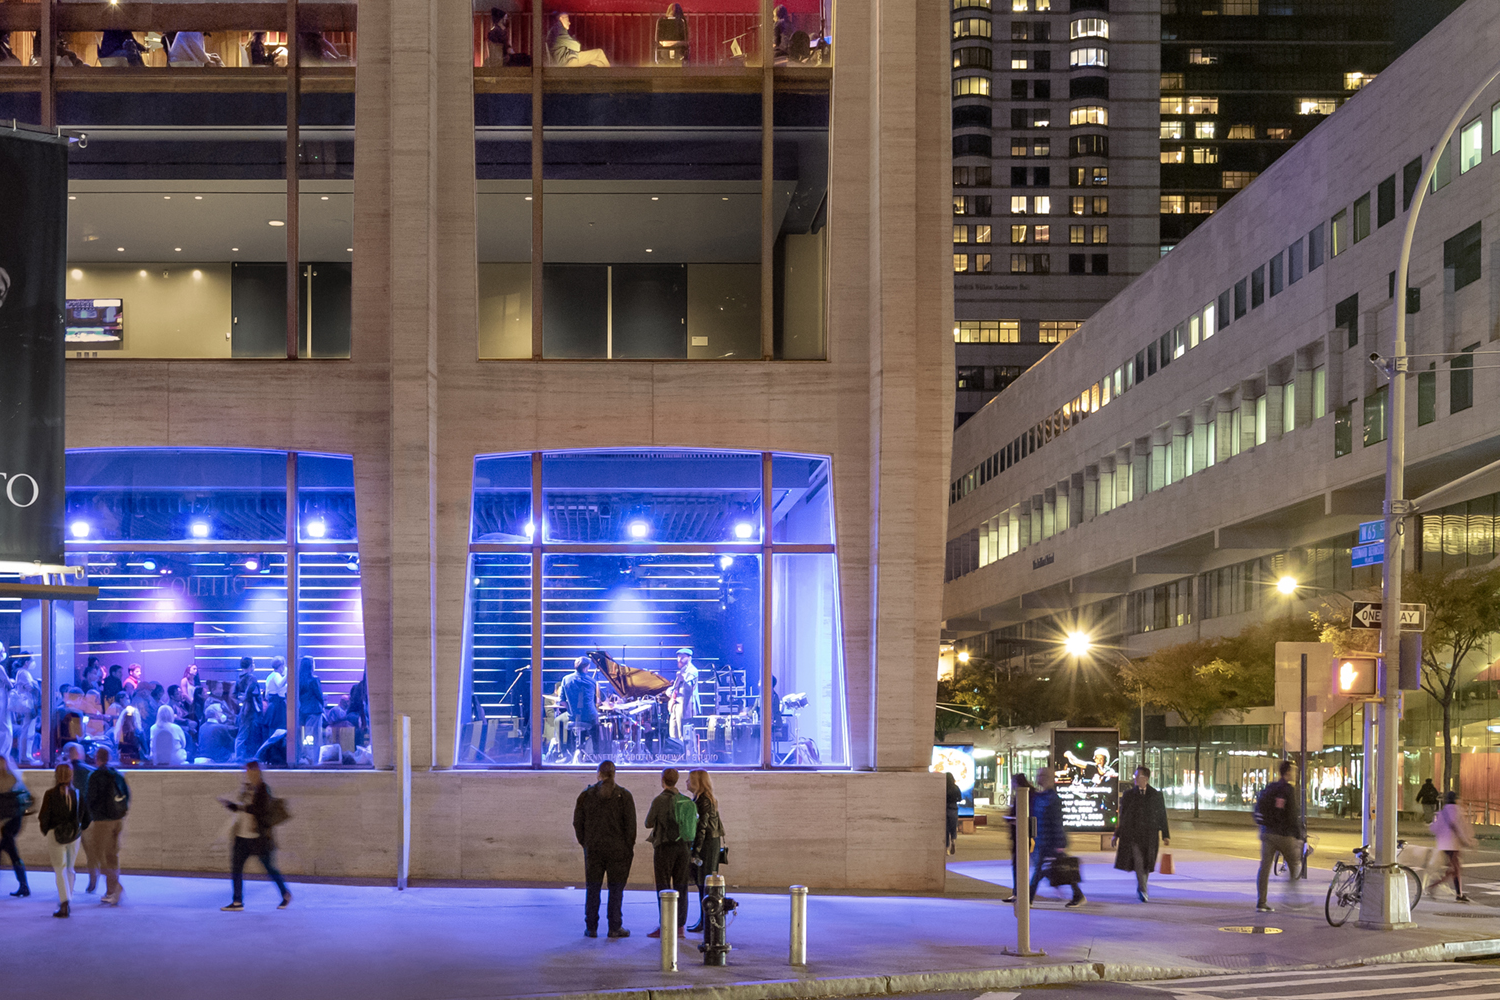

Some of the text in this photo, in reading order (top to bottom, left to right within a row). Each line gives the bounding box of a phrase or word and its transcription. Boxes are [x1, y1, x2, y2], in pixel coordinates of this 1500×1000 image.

[1367, 524, 1377, 540] 65
[1361, 610, 1416, 623] ONE AY
